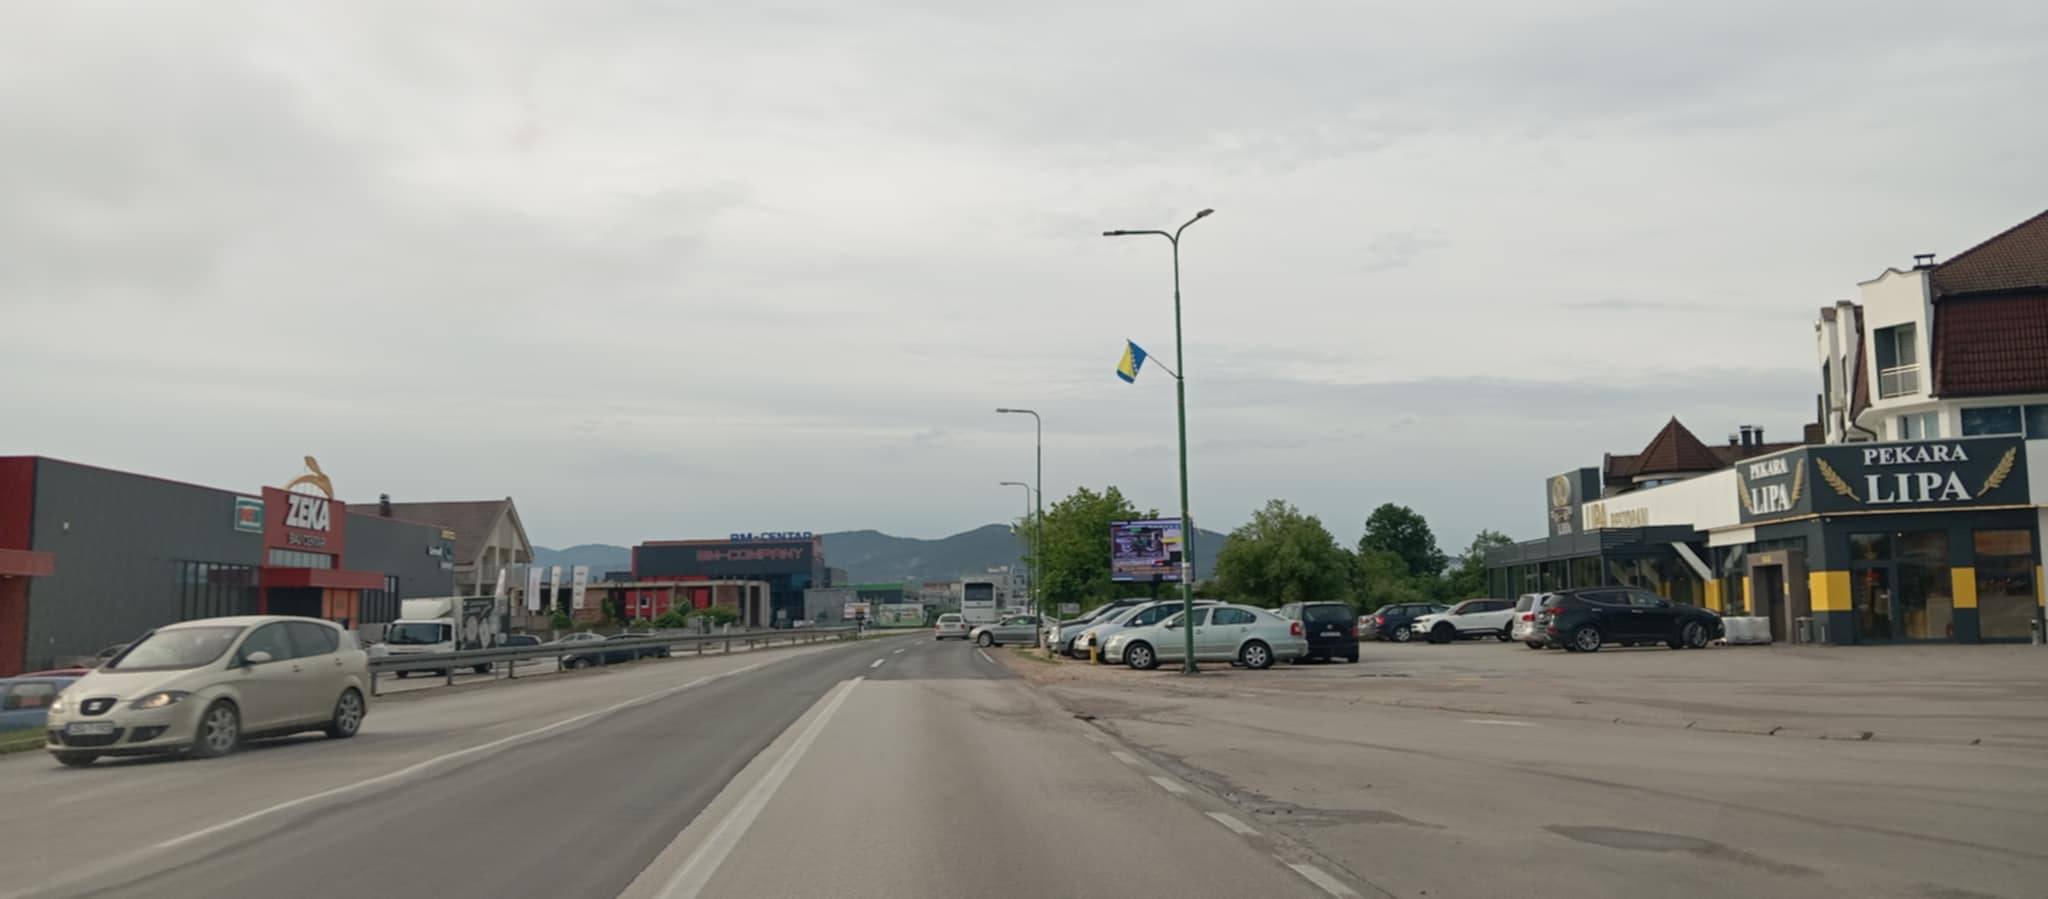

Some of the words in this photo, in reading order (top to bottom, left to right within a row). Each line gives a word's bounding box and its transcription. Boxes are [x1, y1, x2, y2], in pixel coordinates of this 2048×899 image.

[1750, 458, 1790, 480] PEKARA
[1863, 444, 1969, 466] PEKARA
[1751, 483, 1792, 515] LIPA
[1864, 470, 1973, 504] LIPA
[285, 494, 331, 532] ZEKA
